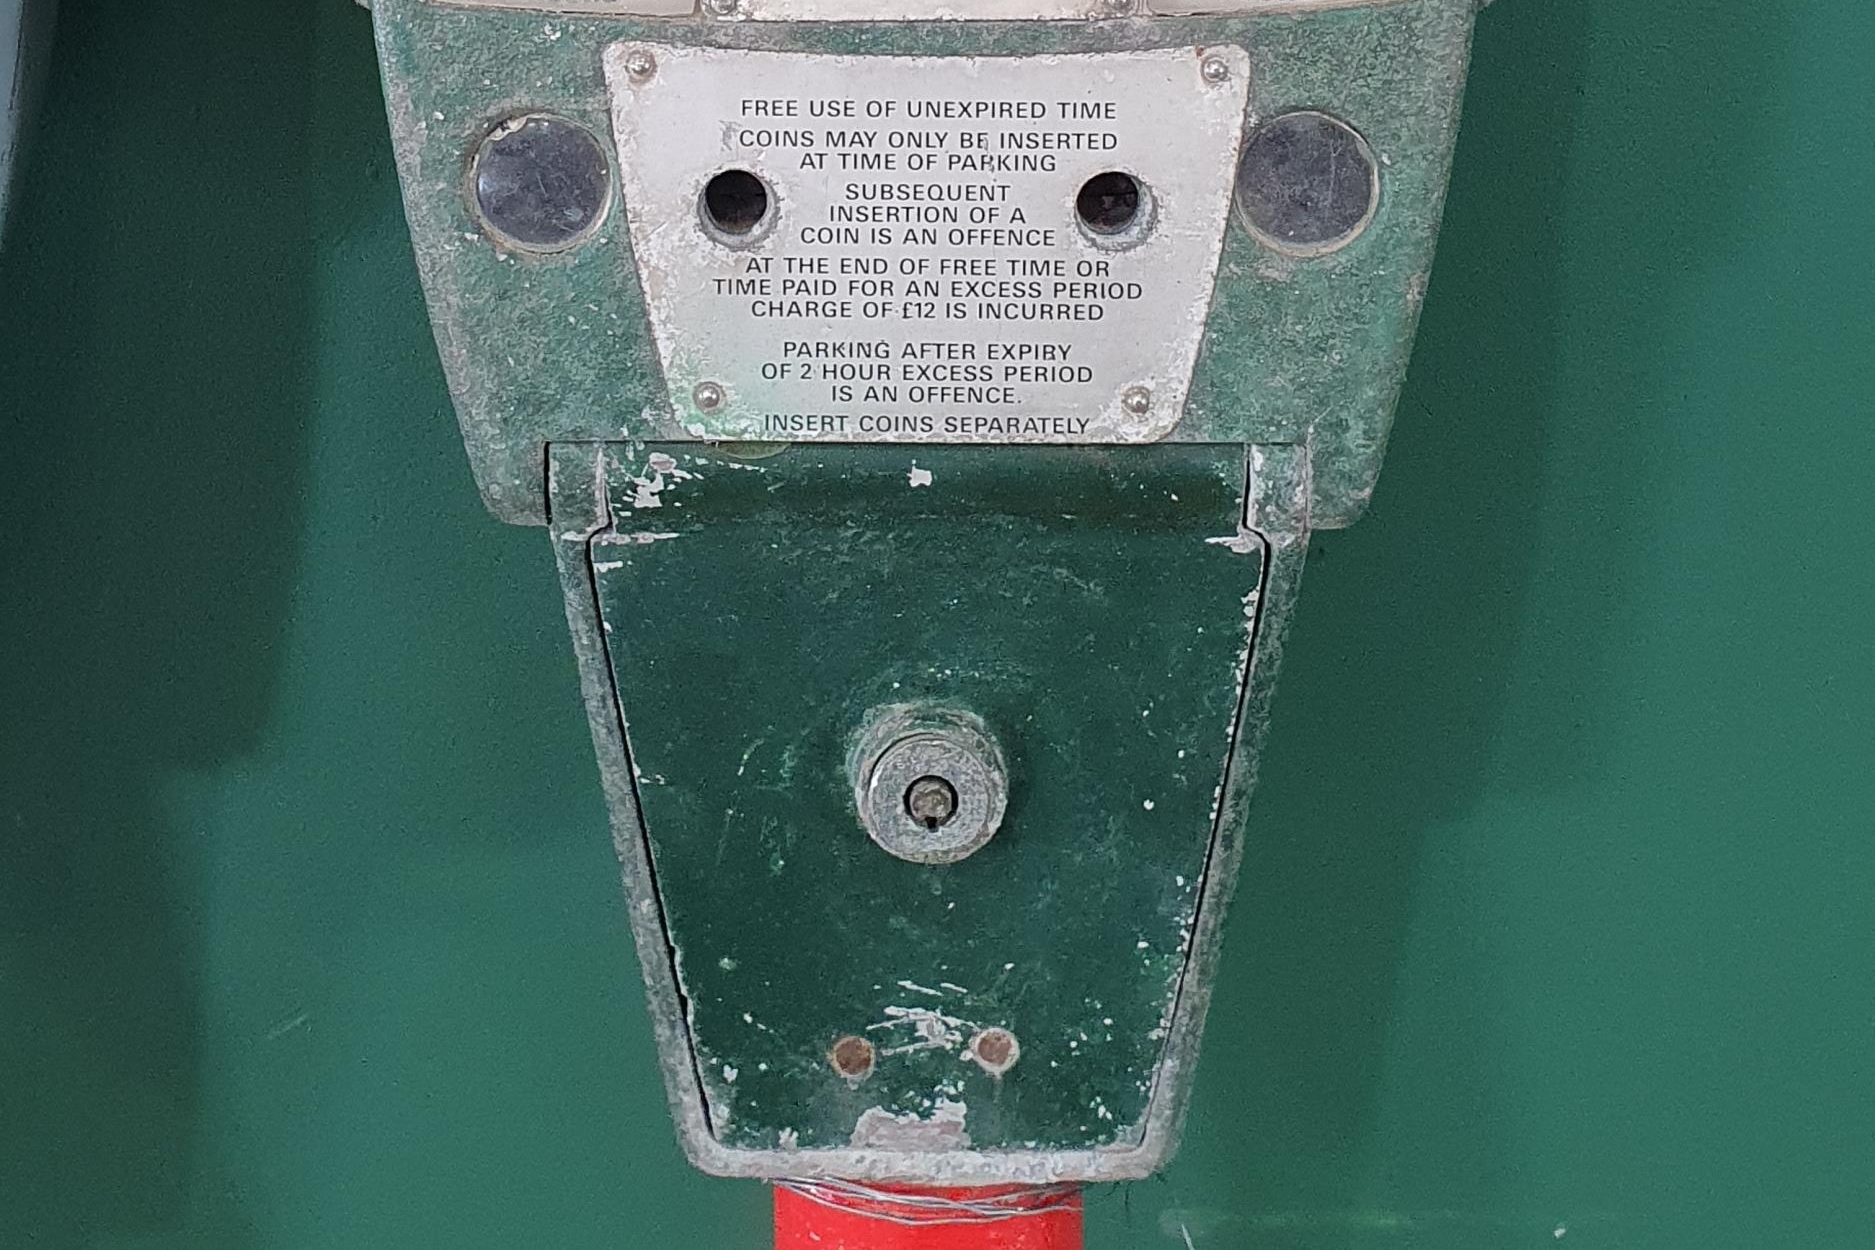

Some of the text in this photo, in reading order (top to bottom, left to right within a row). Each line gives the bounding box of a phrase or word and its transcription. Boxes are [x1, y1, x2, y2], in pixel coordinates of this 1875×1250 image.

[742, 100, 1115, 119] FREE USE OF UNEXPIRED TIME
[740, 130, 1117, 150] COINS MAY ONLY BE INSERTED
[800, 151, 1055, 172] AT TIME OF PARKING
[846, 180, 1010, 201] SUBSEQUENT
[831, 206, 1025, 223] INSERTION OF A
[801, 227, 1054, 246] COIN IS AN OFFENCE
[746, 258, 1108, 277] AT THE END OF FREE TIME OR
[713, 279, 1142, 299] TIME PAID FOR AN EXCESS PERIOD
[752, 301, 1103, 320] CHARGE OF £12 IS INCURRED
[784, 340, 1071, 360] PARKING AFTER EXPIRY
[762, 363, 1092, 382] OF 2 HOUR EXCESS PERIOD
[833, 385, 1021, 403] IS AN OFFENCE.
[762, 415, 1089, 438] INSERT COINS SEPARATELY
